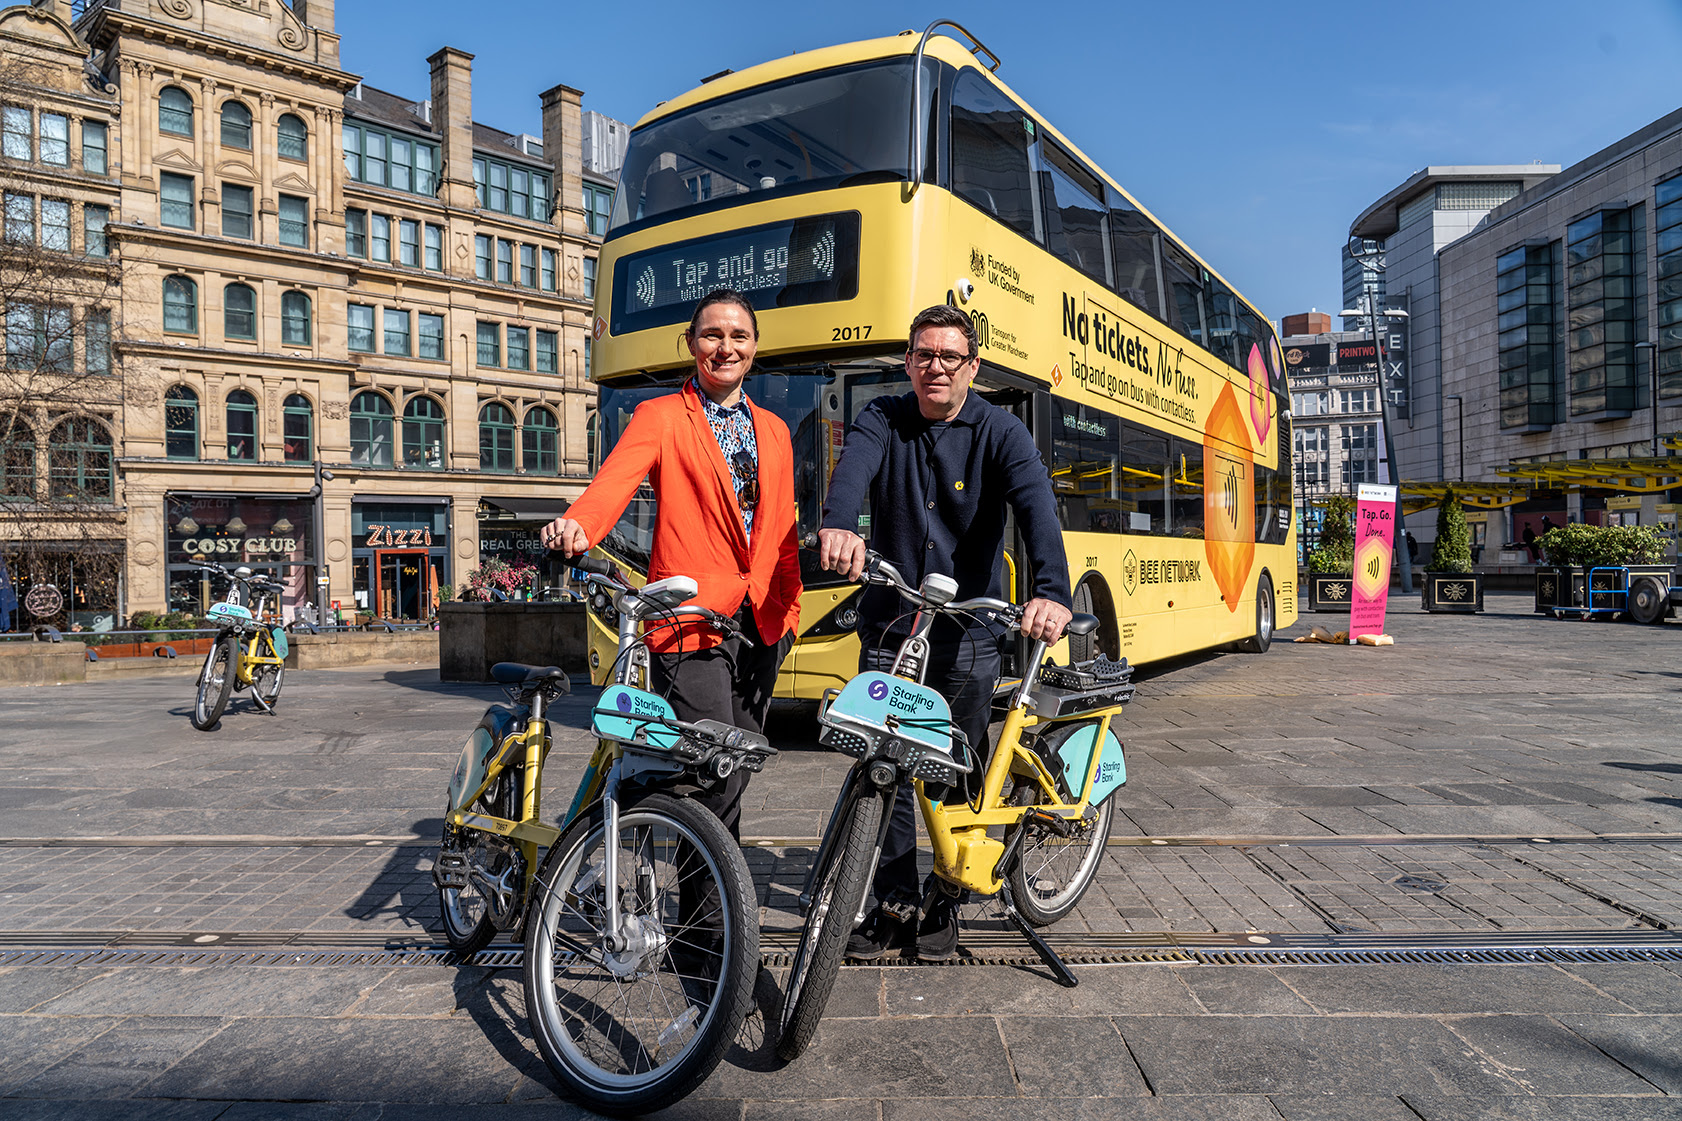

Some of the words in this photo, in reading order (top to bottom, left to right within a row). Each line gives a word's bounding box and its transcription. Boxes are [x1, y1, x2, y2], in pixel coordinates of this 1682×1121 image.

[672, 259, 709, 287] Tap
[717, 245, 754, 279] and
[763, 246, 789, 271] go
[987, 254, 1012, 278] Funded
[1012, 264, 1021, 284] by
[680, 285, 705, 301] with
[987, 271, 999, 285] UK
[1000, 276, 1035, 305] Government
[831, 325, 873, 342] 2017
[991, 324, 1011, 341] Transport
[991, 337, 1007, 351] Greater
[1007, 343, 1029, 360] Manchester
[1062, 291, 1090, 345] No
[1093, 312, 1153, 377] tickets.
[1156, 342, 1173, 388] No
[1174, 347, 1199, 400] fuss.
[1339, 346, 1388, 358] PRINTWOK
[1069, 351, 1089, 388] Tap
[1089, 362, 1106, 388] and
[1106, 373, 1117, 397] go
[1118, 377, 1129, 397] on
[1130, 381, 1144, 404] bus
[1144, 386, 1160, 410] with
[1161, 394, 1197, 424] contactless.
[1077, 419, 1107, 437] contactless
[1362, 508, 1378, 522] Tap.
[1380, 510, 1392, 520] Go.
[365, 524, 432, 547] Zizzi
[510, 531, 527, 539] THE
[1365, 523, 1386, 537] Done.
[182, 538, 241, 554] COSY
[245, 538, 297, 553] CLUB
[480, 539, 513, 550] REAL
[516, 539, 545, 550] GREE
[1086, 556, 1098, 567] 2017
[1140, 560, 1159, 584] BEE
[1160, 560, 1201, 583] NETWORK
[634, 696, 665, 716] Starling
[888, 697, 918, 715] Bank
[892, 685, 935, 711] Starling
[1102, 762, 1121, 772] Starling
[1101, 772, 1114, 782] Bank
